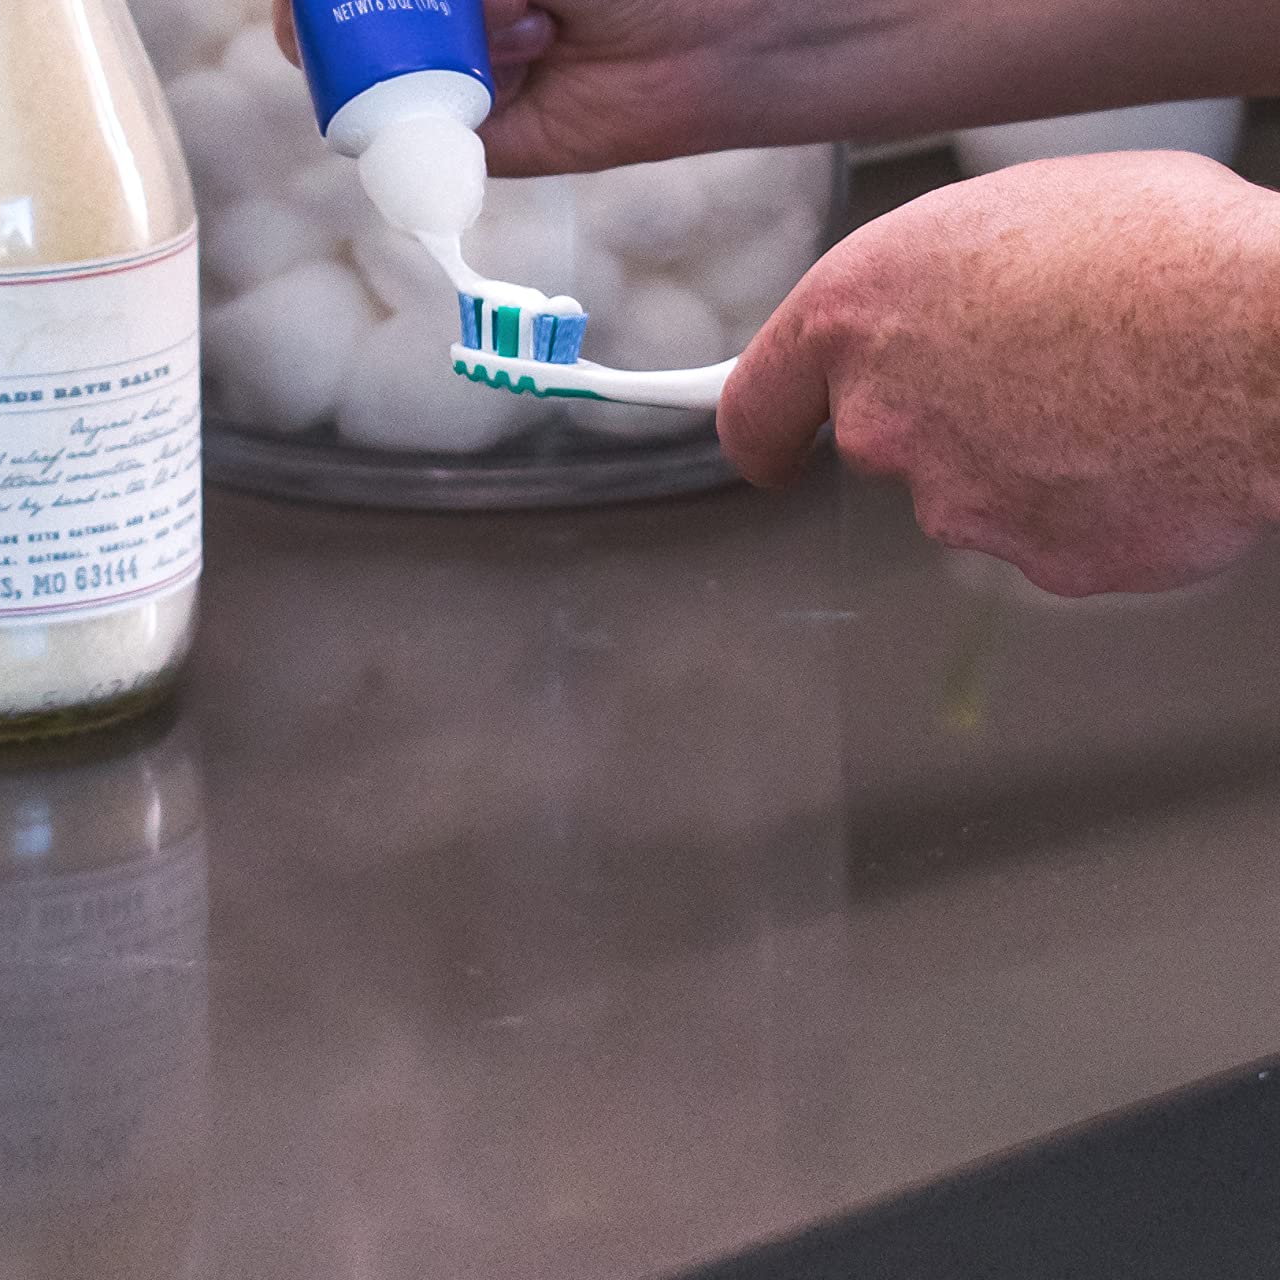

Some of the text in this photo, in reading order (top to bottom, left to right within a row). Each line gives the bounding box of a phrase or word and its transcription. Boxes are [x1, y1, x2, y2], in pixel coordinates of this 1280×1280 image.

[332, 4, 355, 23] NET
[54, 381, 112, 400] BATH
[120, 364, 170, 389] SALTS
[32, 571, 67, 596] MO
[75, 554, 139, 591] 63144
